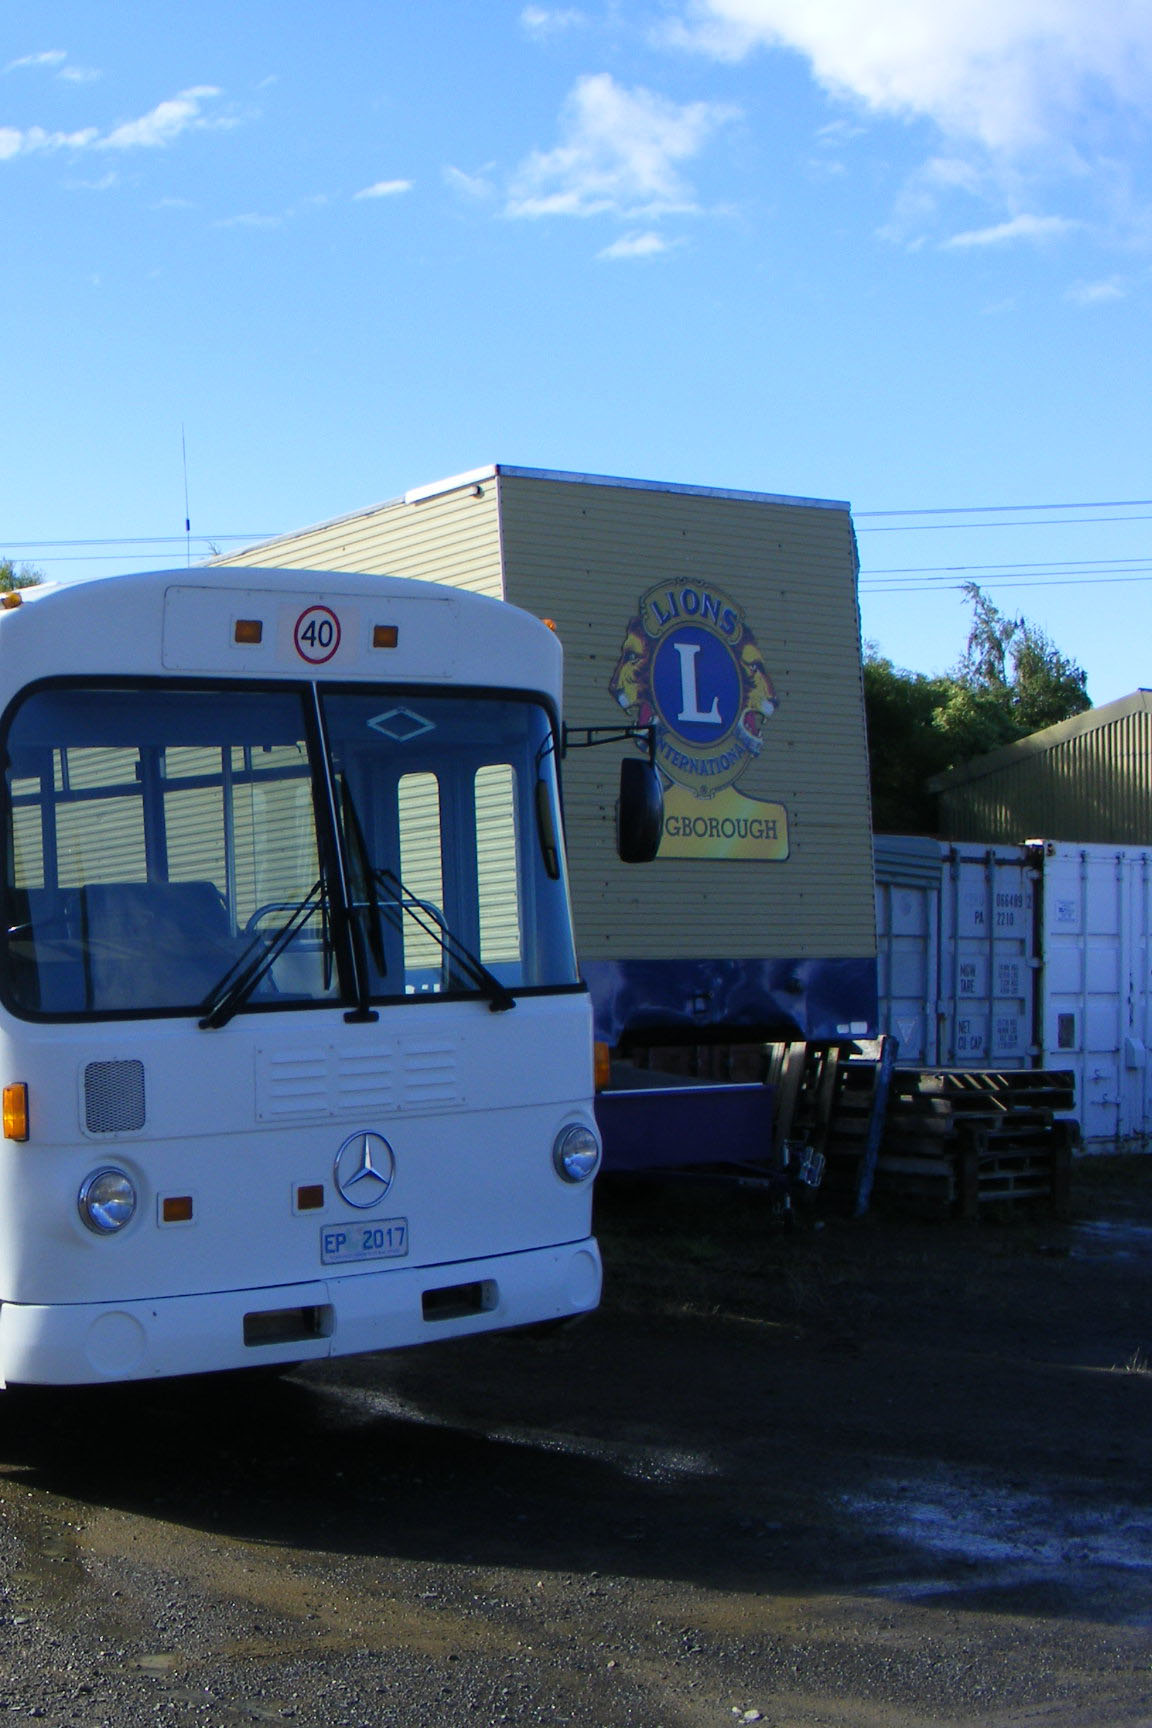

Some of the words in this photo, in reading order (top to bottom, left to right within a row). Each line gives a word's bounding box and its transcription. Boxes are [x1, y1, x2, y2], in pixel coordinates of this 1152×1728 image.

[649, 588, 739, 636] LIONS
[301, 620, 333, 648] 40
[673, 643, 723, 724] L
[656, 739, 746, 776] NTERNATIONA
[665, 815, 778, 840] GBOROUGH
[324, 1233, 346, 1254] EP
[362, 1227, 405, 1250] 2017
